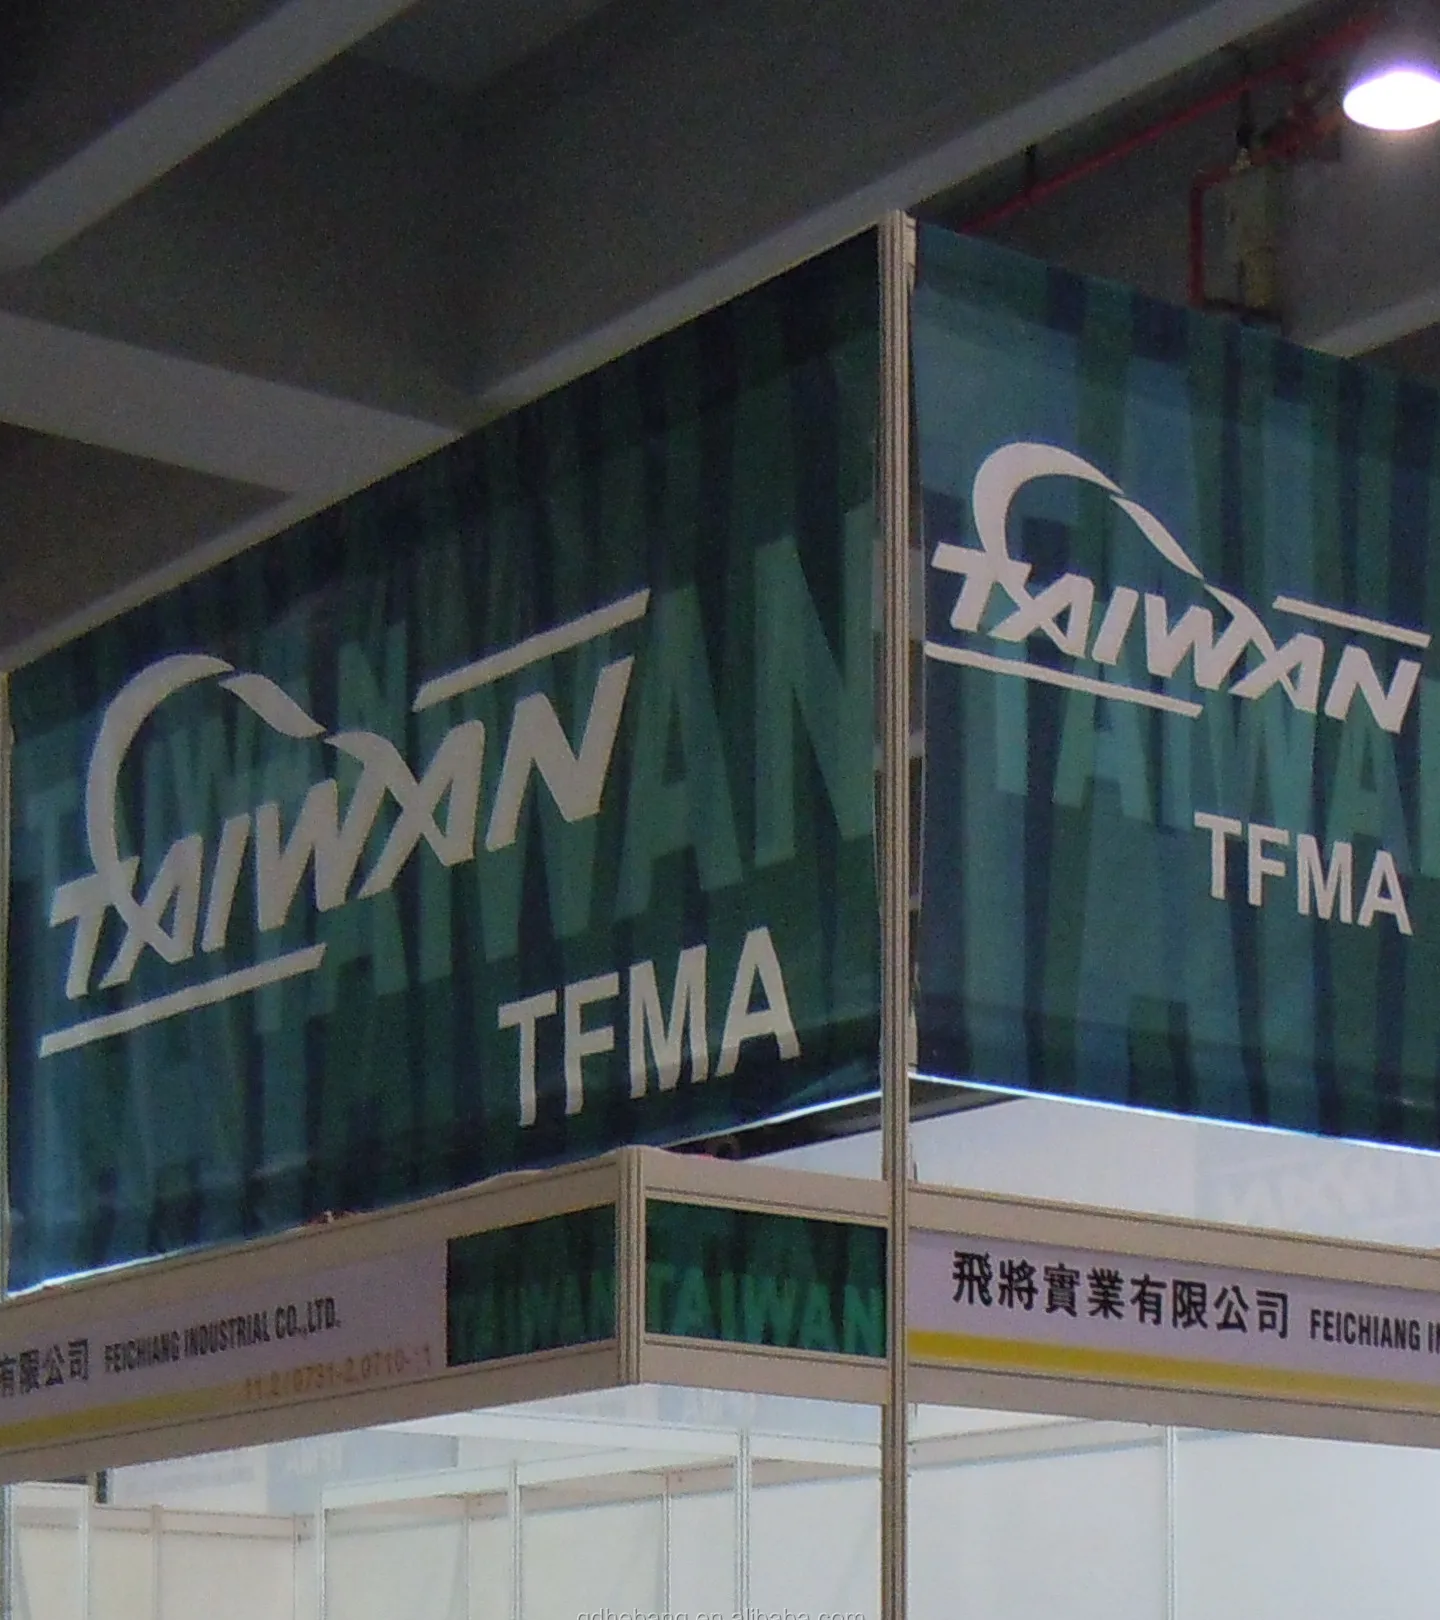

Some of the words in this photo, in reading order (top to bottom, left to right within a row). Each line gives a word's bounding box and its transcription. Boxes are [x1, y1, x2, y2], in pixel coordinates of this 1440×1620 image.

[932, 543, 1421, 733] TAIWAN
[49, 655, 635, 1000] TAIWAN
[1193, 811, 1413, 935] TFMA
[497, 926, 801, 1128] TFMA
[103, 1331, 181, 1374] FEICHIANG
[184, 1310, 271, 1358] INDUSTRIAL
[952, 1249, 1289, 1340] 飛將實業有限公司
[1310, 1308, 1420, 1351] FEICHIANG
